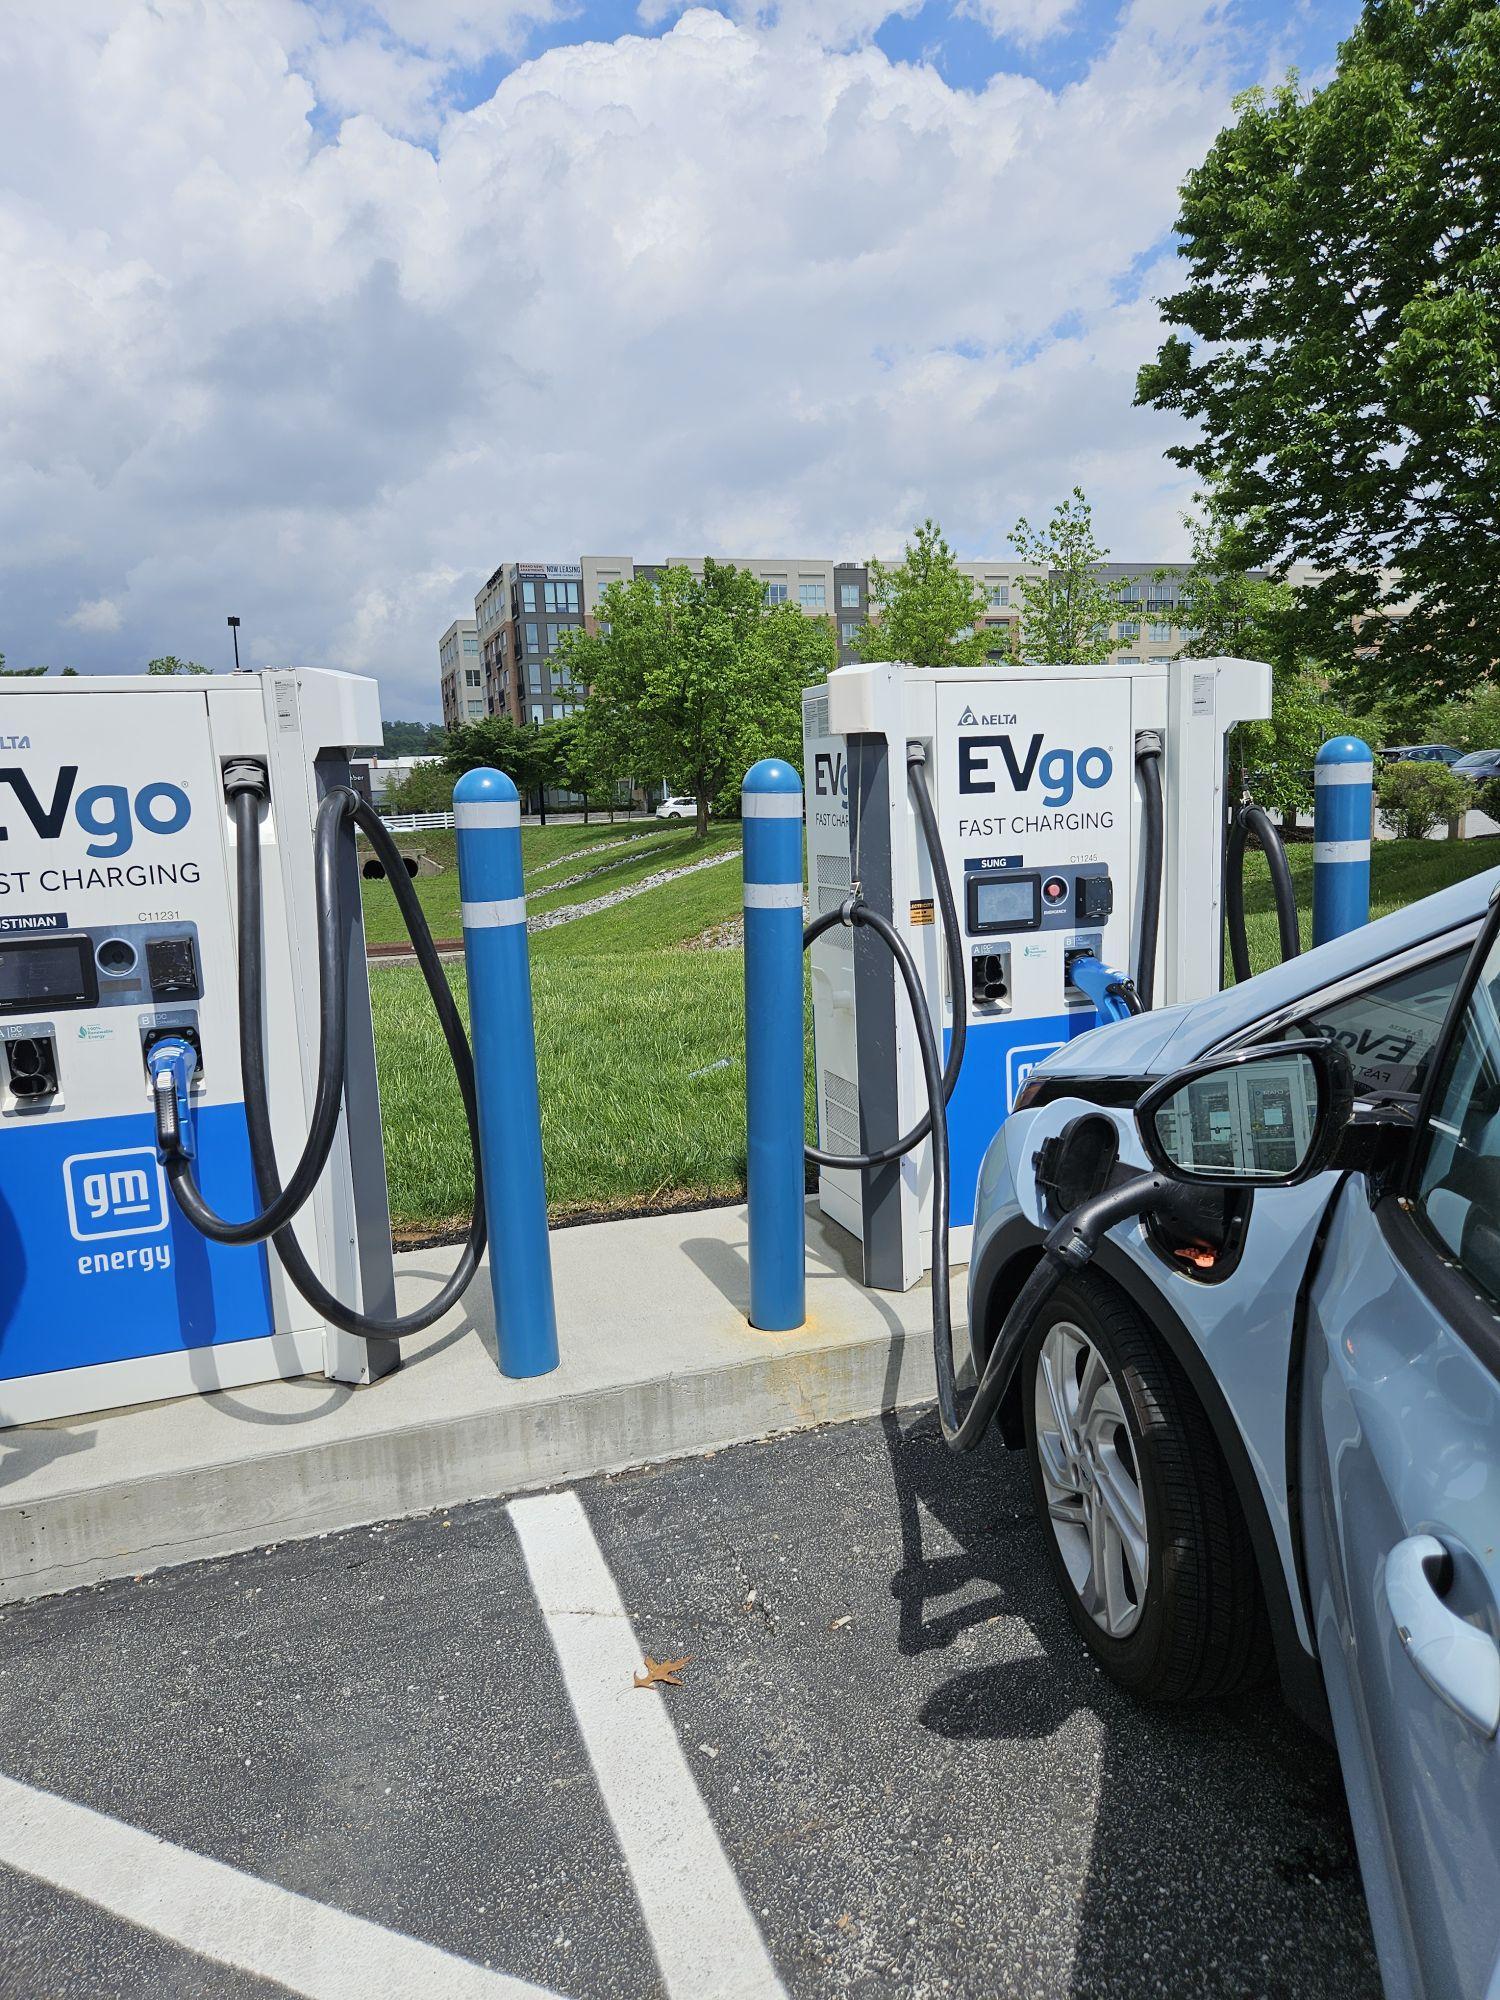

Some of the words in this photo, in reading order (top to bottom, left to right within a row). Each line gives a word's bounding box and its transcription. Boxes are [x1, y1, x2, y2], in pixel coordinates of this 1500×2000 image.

[546, 565, 558, 573] NOW
[559, 565, 580, 574] LEASING
[981, 714, 1017, 726] DELTA
[958, 733, 1113, 808] EVgo
[815, 813, 831, 826] FAST
[958, 818, 1006, 837] FAST
[1011, 811, 1114, 834] CHARGING
[981, 858, 1007, 868] SUNG
[39, 862, 201, 892] CHARGING
[138, 911, 180, 922] C11231
[973, 946, 981, 954] A
[142, 1016, 150, 1025] B
[83, 1169, 150, 1219] gm
[78, 1244, 171, 1275] energy
